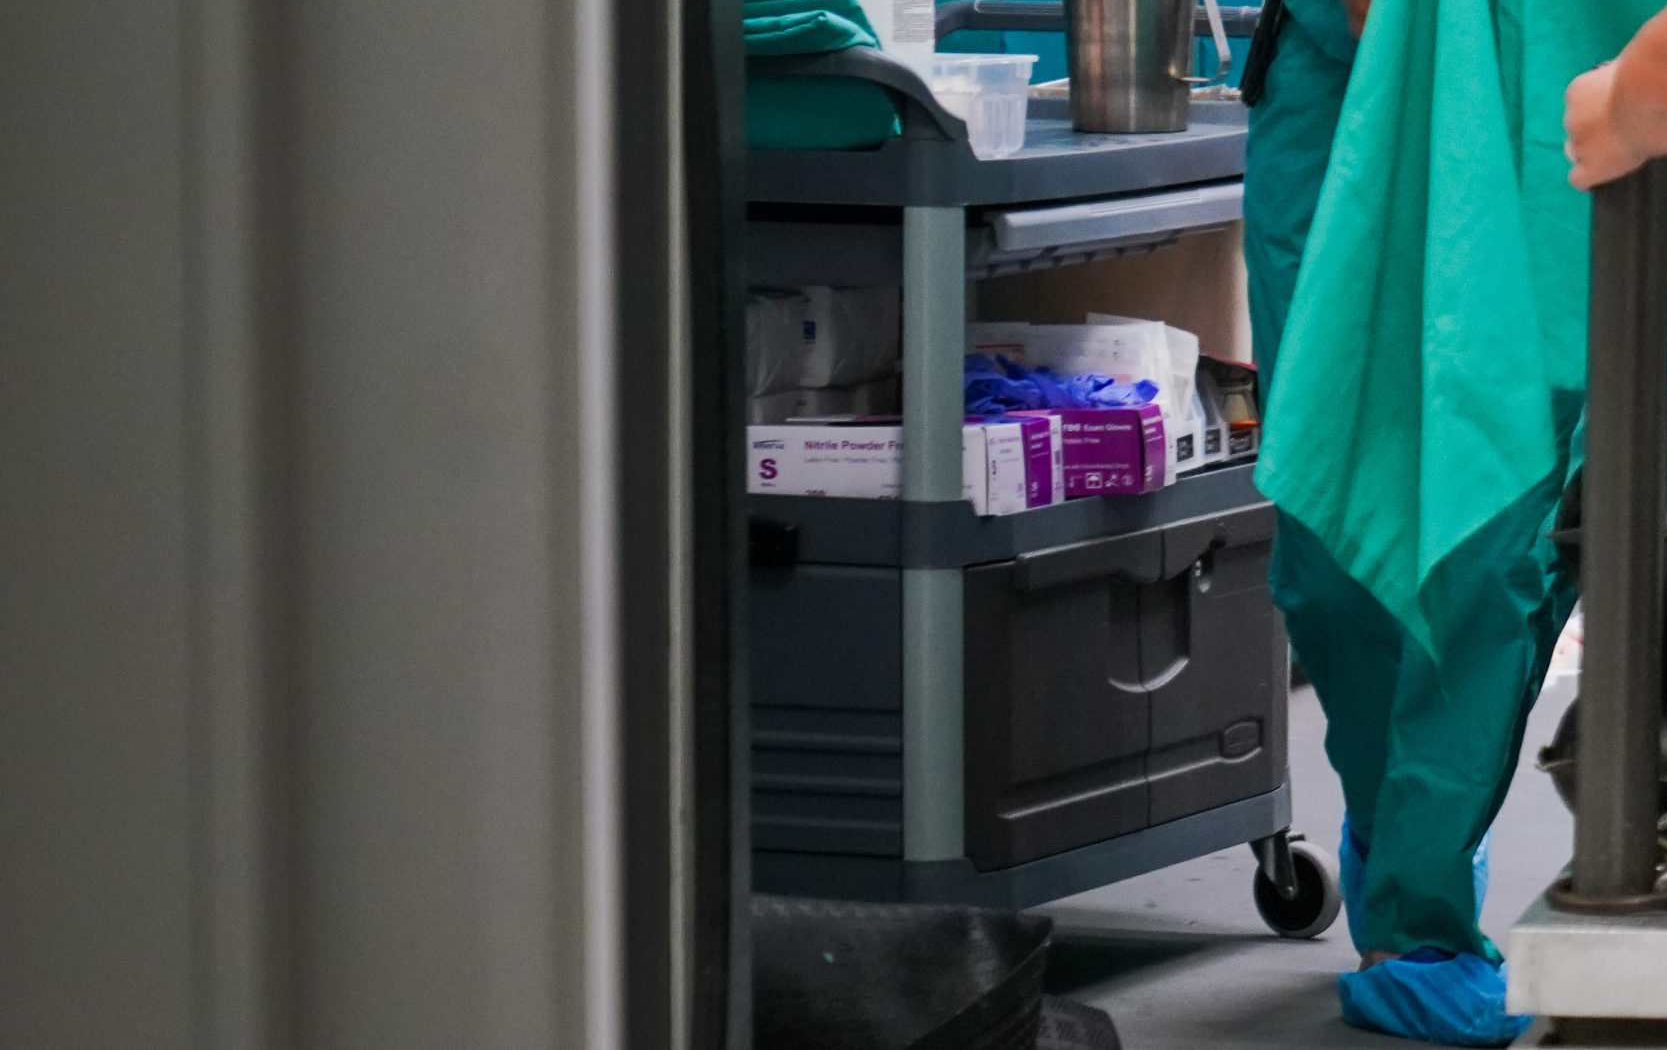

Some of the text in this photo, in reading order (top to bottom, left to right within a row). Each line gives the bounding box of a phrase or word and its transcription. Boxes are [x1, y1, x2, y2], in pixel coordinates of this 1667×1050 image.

[1062, 423, 1081, 432] ree
[804, 440, 838, 450] Nitrile
[842, 440, 886, 450] Powder
[758, 458, 778, 480] S
